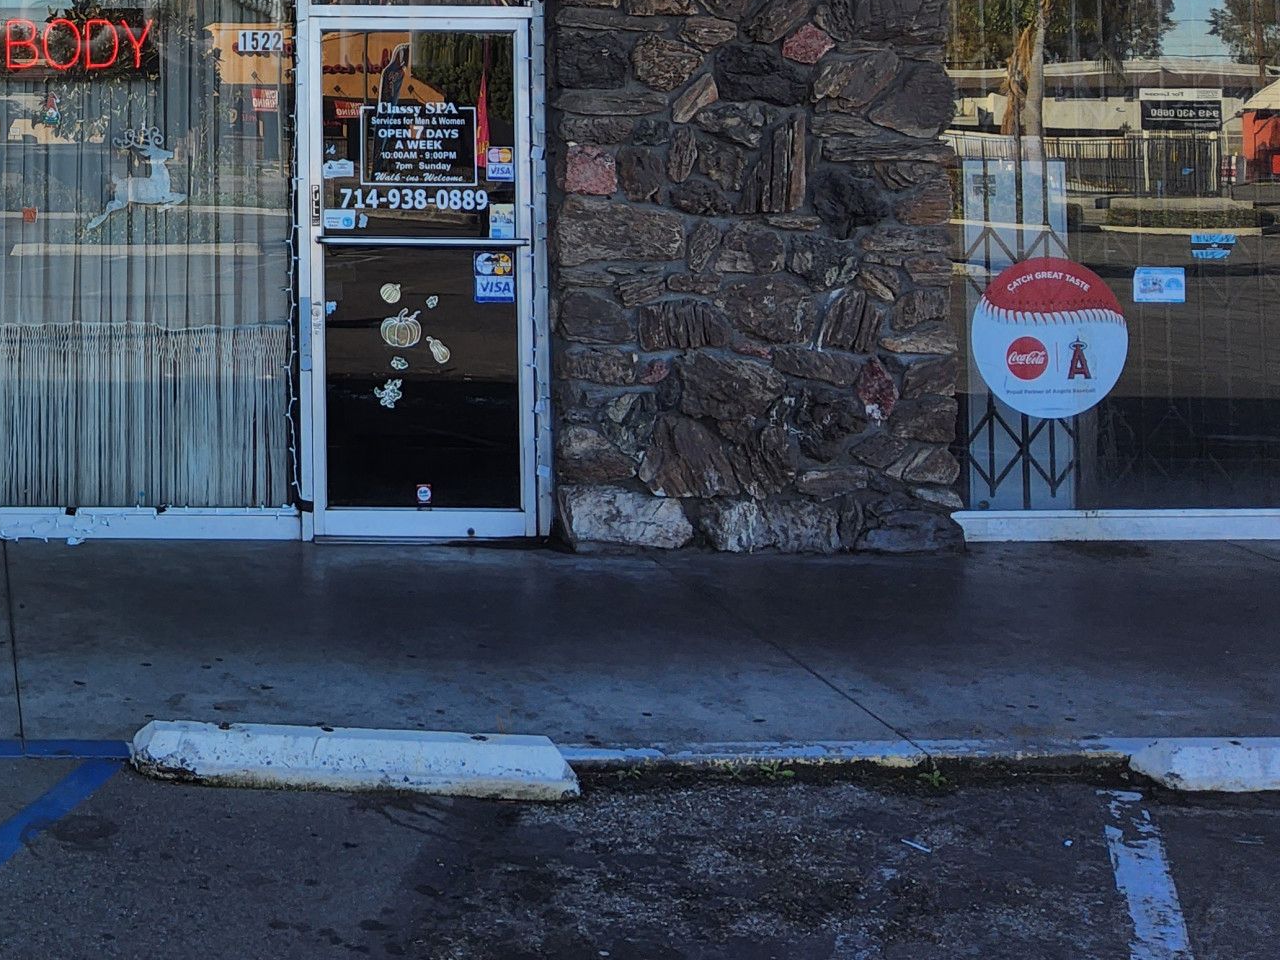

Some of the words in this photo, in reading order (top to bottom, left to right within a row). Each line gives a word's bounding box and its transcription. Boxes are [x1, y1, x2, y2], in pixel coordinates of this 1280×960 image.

[5, 18, 154, 71] BODY
[240, 31, 282, 51] 1522
[378, 101, 422, 117] Classy
[425, 101, 459, 114] SPA
[371, 116, 402, 125] Services
[403, 116, 413, 125] for
[432, 117, 437, 125] &
[438, 117, 466, 125] Women
[378, 128, 412, 138] OPEN
[413, 125, 424, 139] 7
[426, 128, 459, 138] DAYS
[395, 140, 404, 149] A
[407, 140, 442, 149] WEEK
[381, 151, 418, 159] 10:00AM
[424, 151, 457, 159] 9:00PM
[395, 162, 413, 171] 7pm
[418, 161, 452, 171] Sunday
[490, 166, 511, 175] VISA
[422, 172, 464, 182] Welcome
[312, 185, 320, 217] PULL
[340, 188, 488, 211] 714-938-0889
[480, 281, 512, 293] VISA
[1007, 273, 1033, 292] CATCH
[1035, 271, 1064, 280] GREAT
[1065, 273, 1091, 293] TASTE
